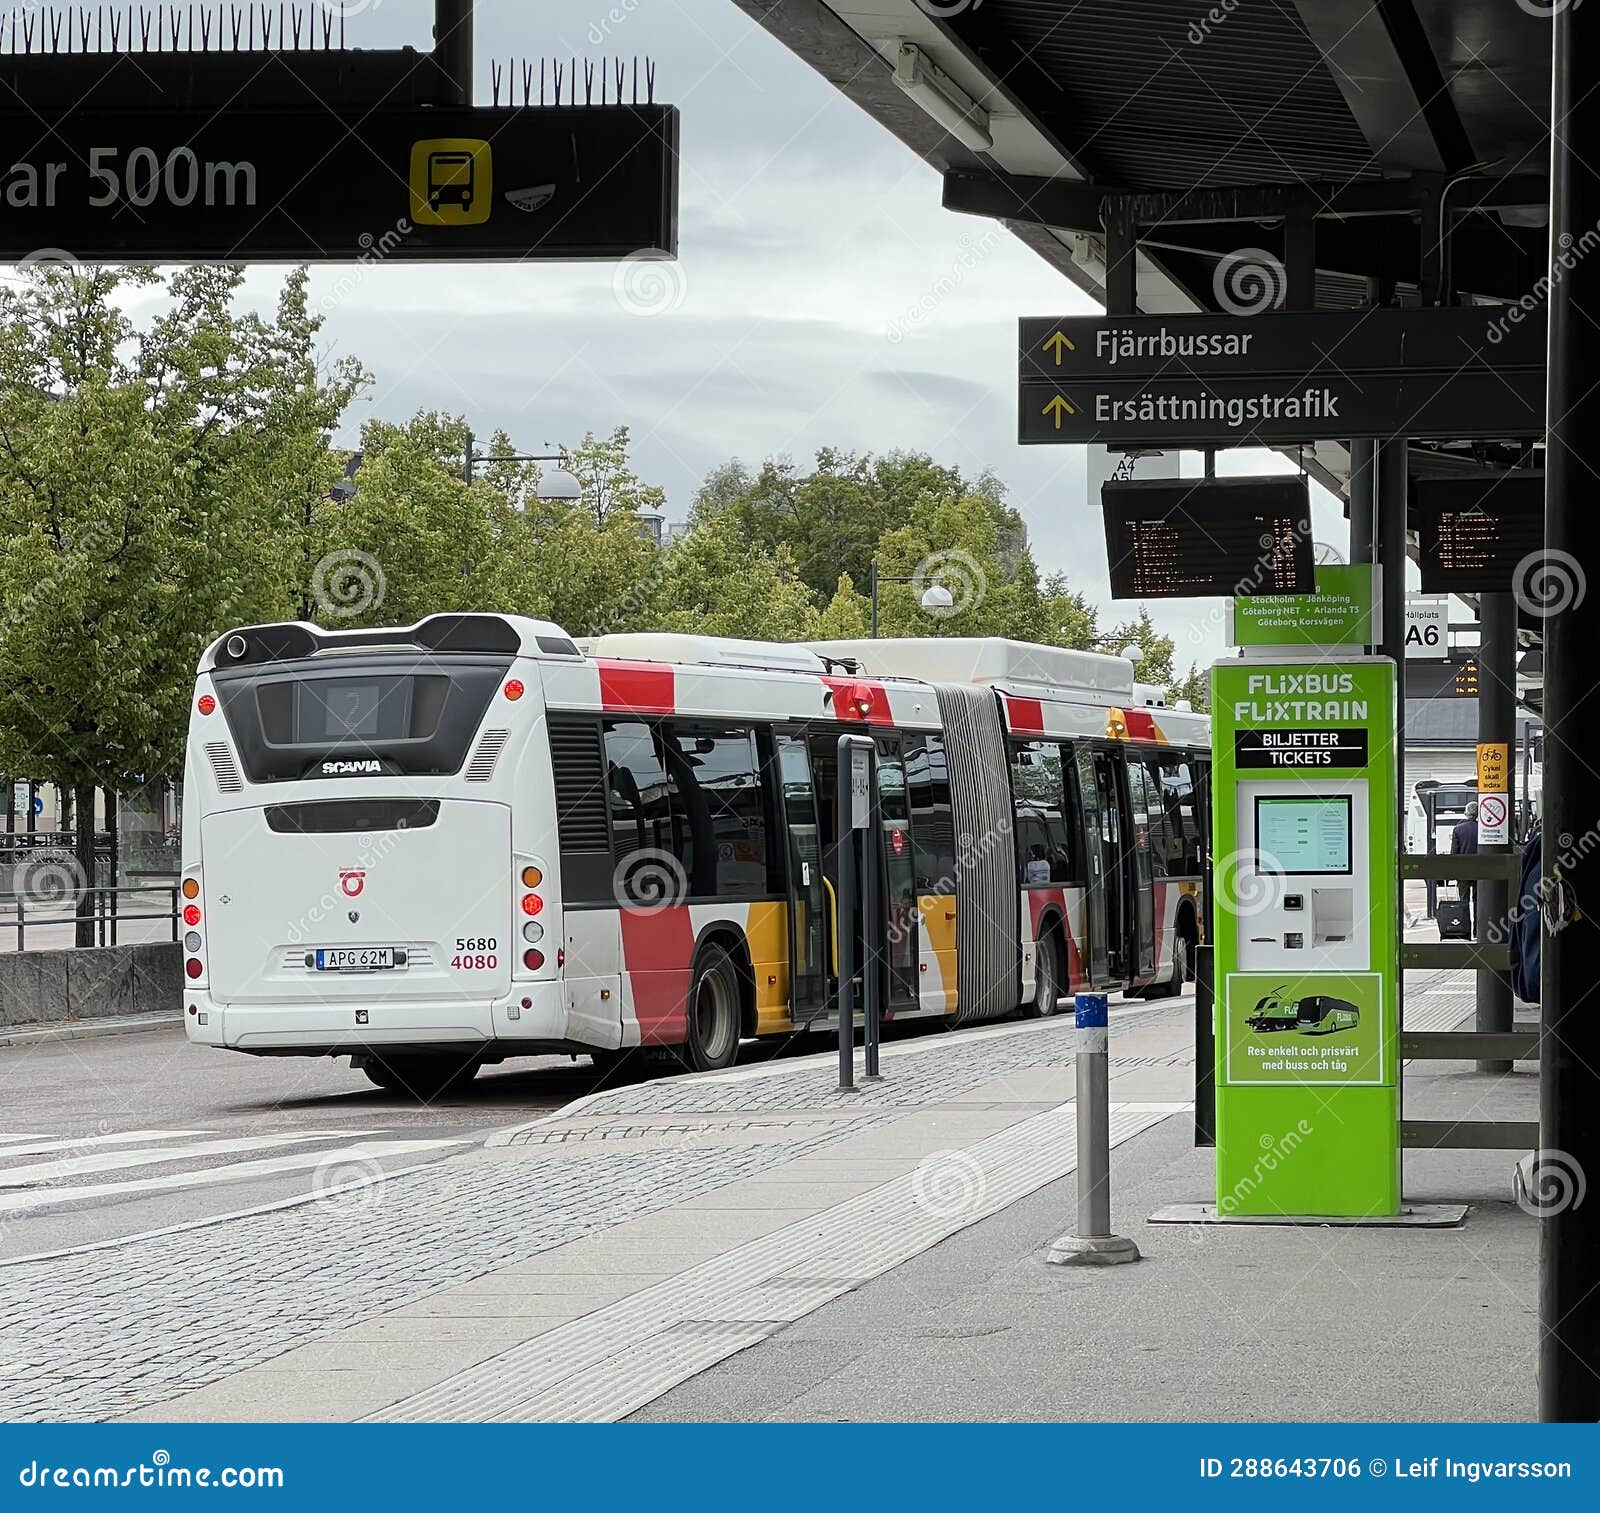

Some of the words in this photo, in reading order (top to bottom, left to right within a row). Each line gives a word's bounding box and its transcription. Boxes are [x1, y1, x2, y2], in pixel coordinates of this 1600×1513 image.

[89, 147, 257, 206] 500m
[1096, 328, 1253, 364] Fjärrbussar
[1096, 388, 1339, 426] Ersättningstrafik
[1117, 460, 1134, 471] A4
[1251, 595, 1295, 604] Stockholm
[1306, 594, 1350, 604] Jönköping
[1242, 607, 1282, 616] Göteborg
[1283, 607, 1300, 615] NET
[1314, 606, 1347, 615] Arlanda
[1258, 618, 1297, 627] Göteborg
[1299, 617, 1344, 626] Korsvägen
[1405, 624, 1440, 646] A6
[1263, 733, 1339, 746] BILJETTER
[1269, 751, 1331, 764] TICKETS
[322, 760, 382, 773] SCANIA
[455, 938, 497, 951] 5680
[329, 952, 356, 966] APG
[360, 951, 387, 965] 62M
[450, 955, 498, 970] 4080
[1247, 1046, 1265, 1056] Res
[1268, 1046, 1298, 1056] enkelt
[1301, 1046, 1318, 1056] och
[1321, 1046, 1359, 1058] prisvärt
[1262, 1060, 1283, 1070] med
[1286, 1060, 1309, 1070] buss
[1311, 1060, 1329, 1070] och
[1331, 1060, 1347, 1072] tåg
